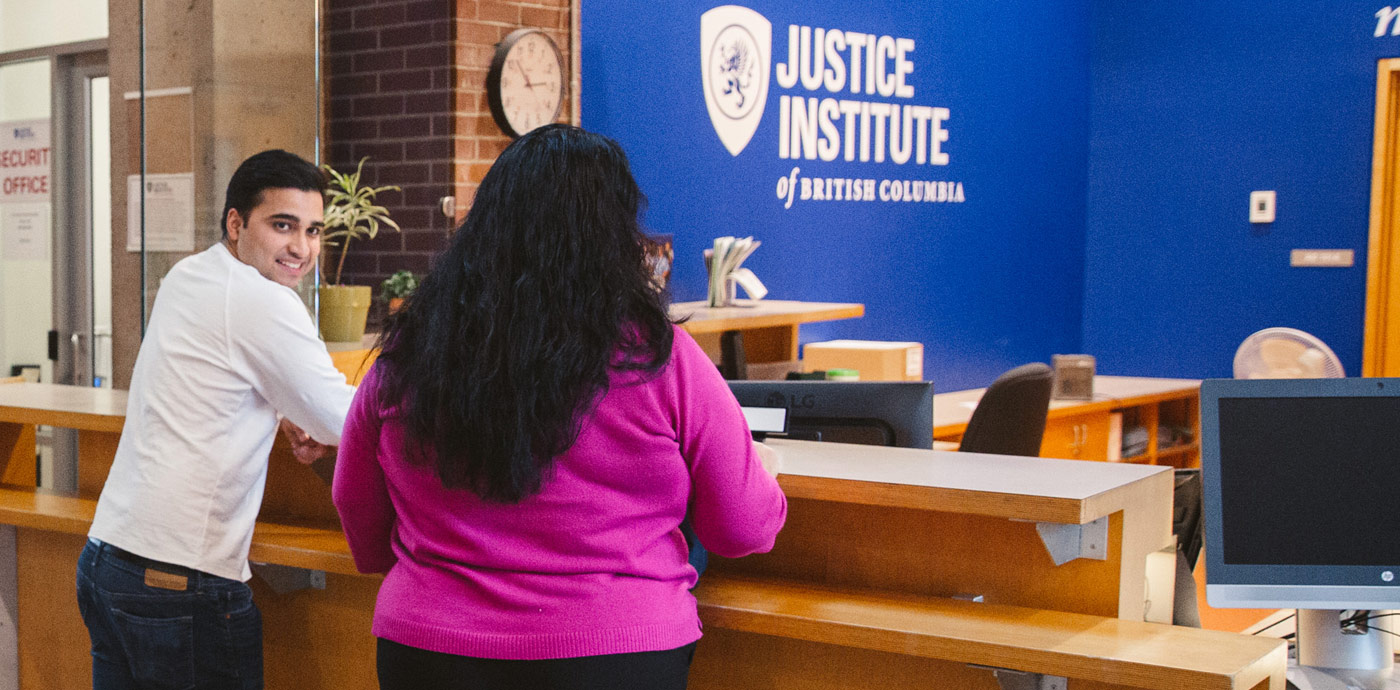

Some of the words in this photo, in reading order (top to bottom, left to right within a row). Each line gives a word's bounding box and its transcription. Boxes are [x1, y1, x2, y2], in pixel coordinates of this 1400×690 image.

[776, 24, 915, 98] JUSTICE
[779, 95, 950, 166] INSTITUTE
[3, 175, 48, 195] OFFICE
[776, 166, 800, 209] of
[800, 177, 876, 201] BRITISH
[879, 179, 966, 203] COLUMBIA
[791, 394, 815, 409] LG
